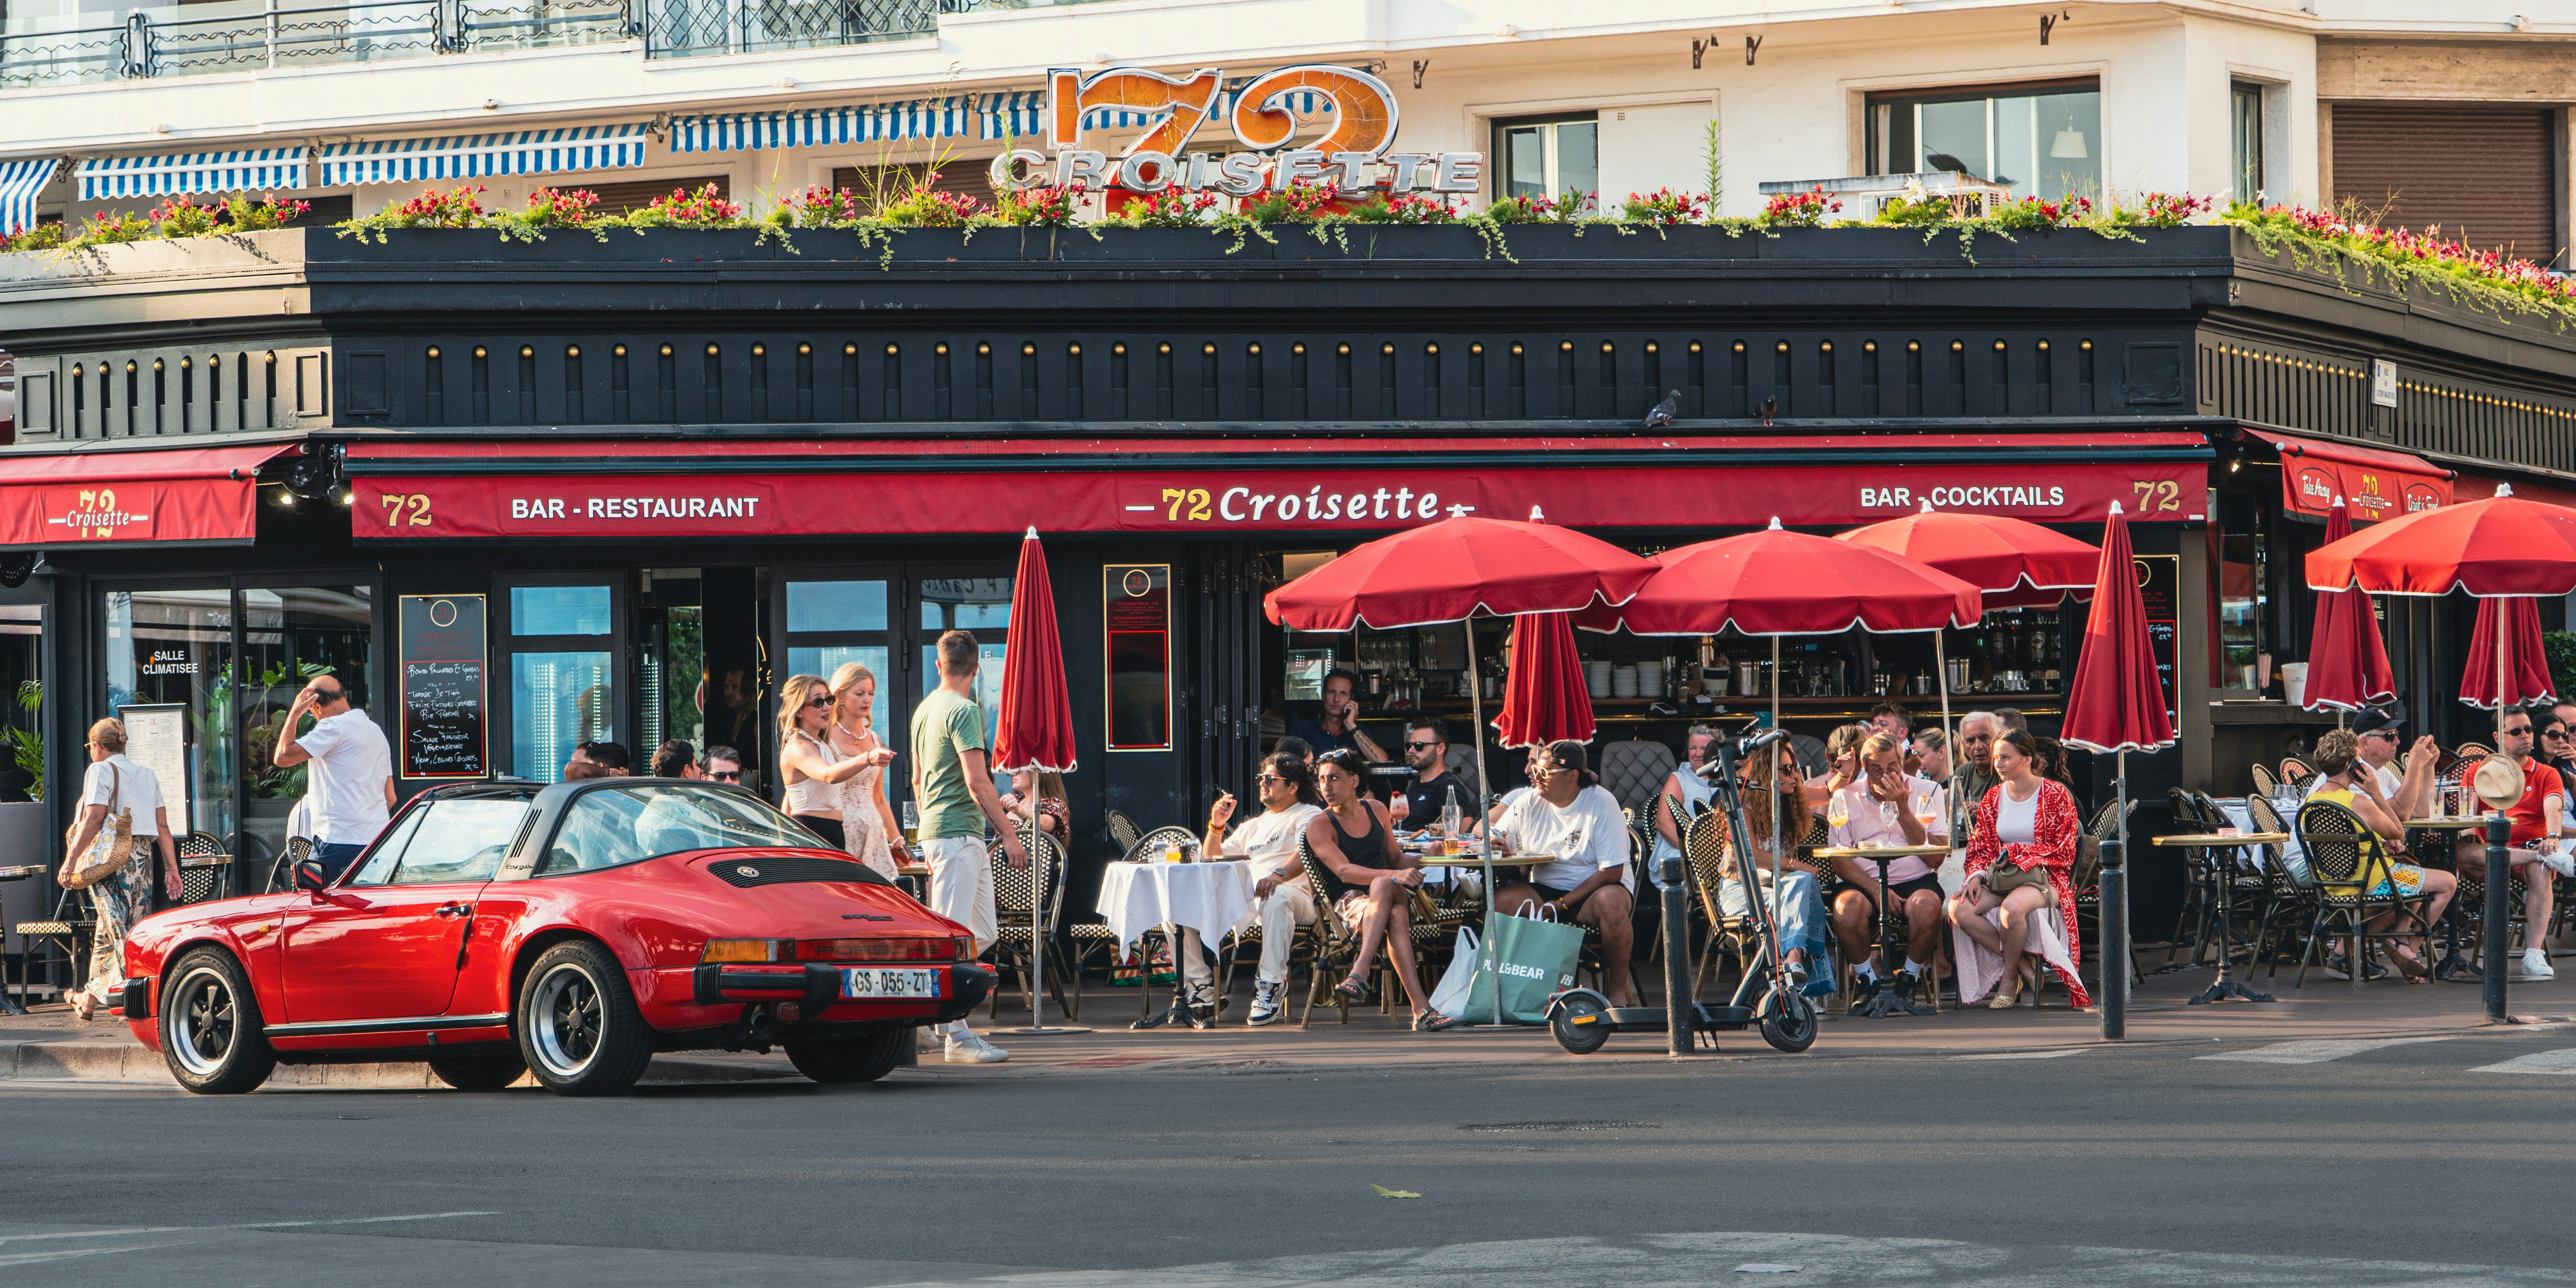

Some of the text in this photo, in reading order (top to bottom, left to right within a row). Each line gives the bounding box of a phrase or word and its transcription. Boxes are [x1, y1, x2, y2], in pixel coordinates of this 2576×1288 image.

[1047, 63, 1399, 219] 72
[990, 149, 1486, 198] CROISETTE
[1861, 488, 1911, 508] BAR
[1931, 486, 2065, 507] COCKTAILS
[2133, 479, 2180, 512] 72
[2302, 475, 2330, 504] Take Away
[2359, 491, 2384, 509] Croisette
[2362, 473, 2378, 519] 72
[381, 493, 433, 527] 72
[512, 499, 566, 519] BAR
[587, 497, 759, 518] RESTAURANT
[1162, 484, 1438, 521] 72 Croisette
[67, 509, 129, 527] Croisette
[80, 489, 115, 538] 72
[1131, 575, 1142, 584] 72
[2135, 567, 2142, 575] 2
[154, 650, 185, 661] SALLE
[143, 663, 198, 674] CLIMATISEE
[553, 947, 589, 964] MICHELIN
[816, 945, 939, 956] PORSCHE
[1482, 959, 1545, 980] PUL&BEAR
[932, 984, 939, 994] 06
